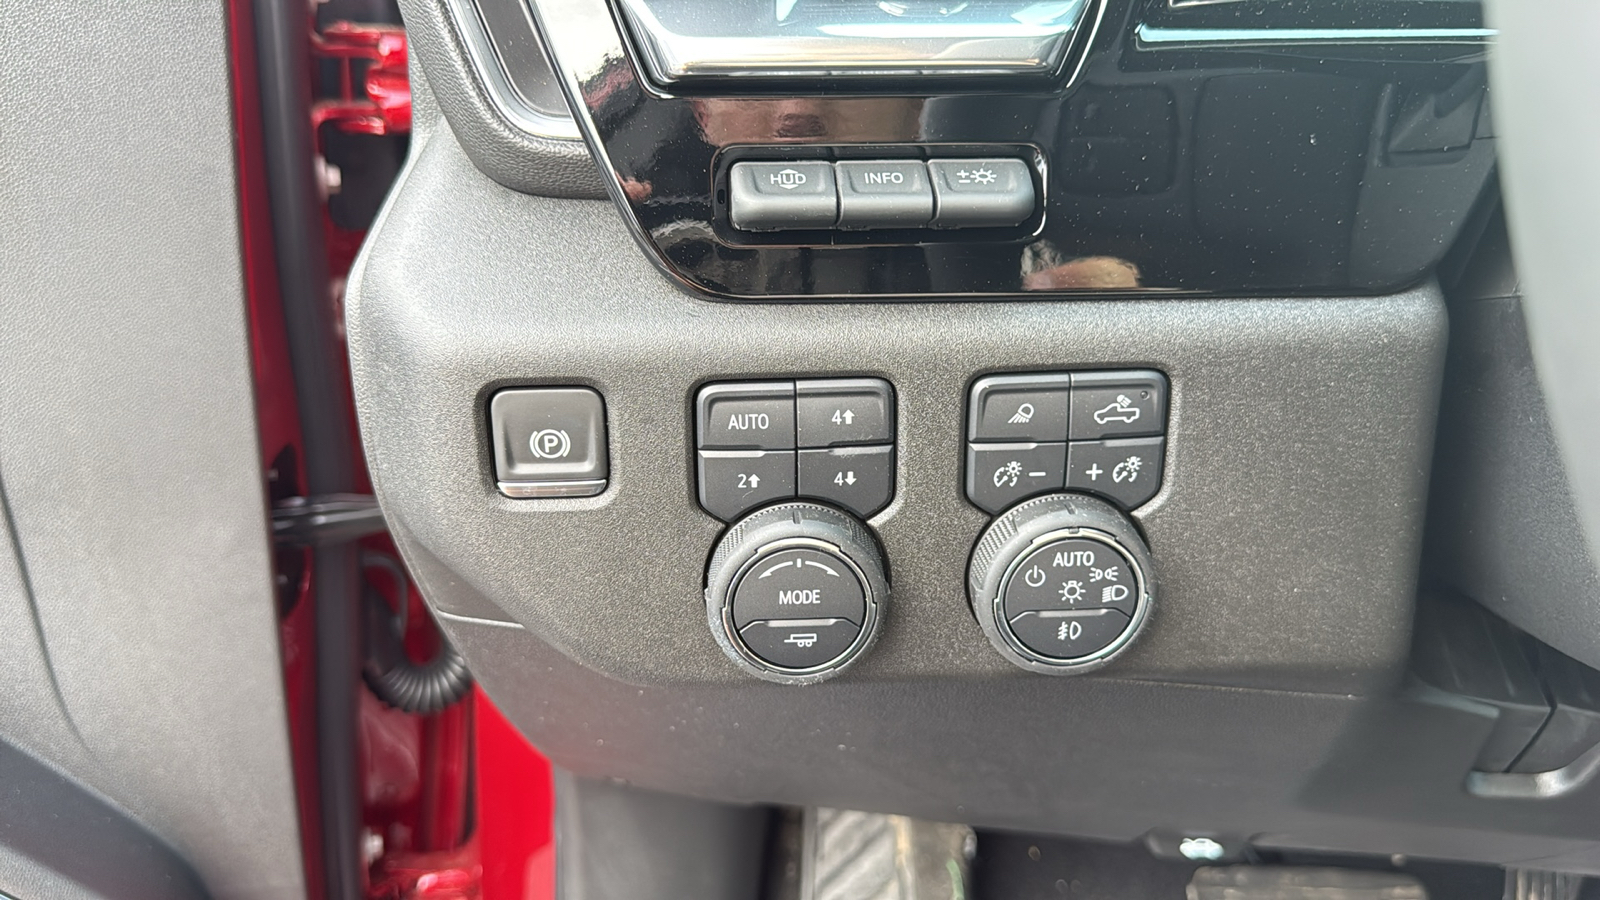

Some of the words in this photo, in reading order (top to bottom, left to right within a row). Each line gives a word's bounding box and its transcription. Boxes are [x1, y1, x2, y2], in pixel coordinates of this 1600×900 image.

[770, 173, 806, 185] HUD
[864, 172, 903, 184] INFO
[728, 413, 769, 430] AUTO
[831, 409, 842, 425] 4
[543, 435, 559, 453] P
[737, 474, 747, 488] 2
[833, 472, 843, 486] 4
[1053, 551, 1094, 567] AUTO
[779, 589, 821, 605] MODE
